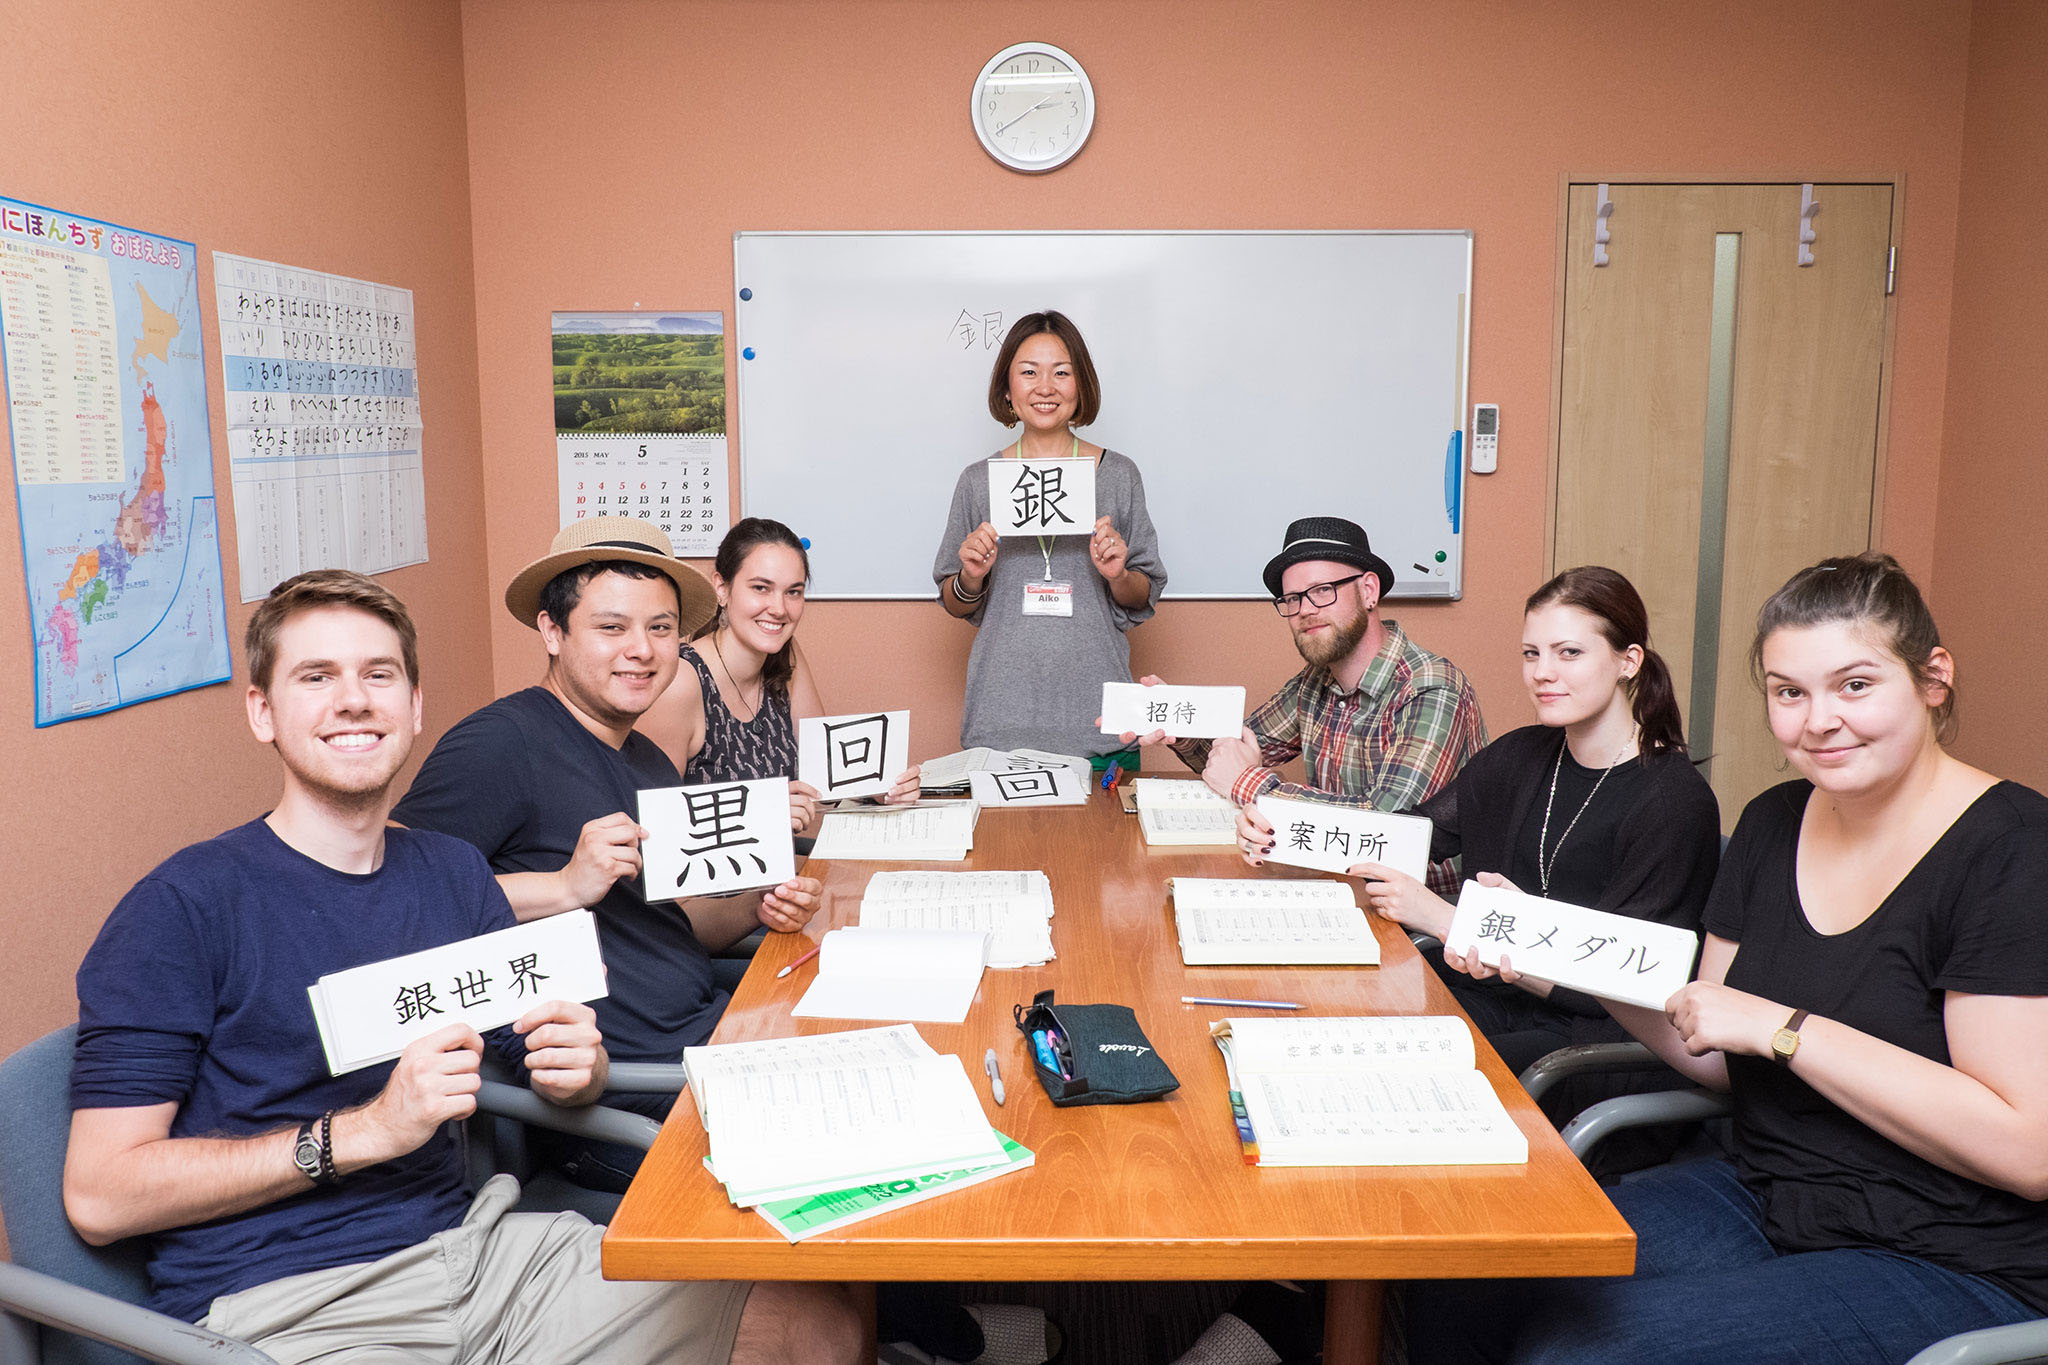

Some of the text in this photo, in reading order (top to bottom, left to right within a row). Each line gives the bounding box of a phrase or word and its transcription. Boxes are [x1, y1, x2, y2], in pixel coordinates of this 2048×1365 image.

[1010, 65, 1020, 77] 11
[1028, 60, 1040, 73] 12
[994, 82, 1071, 95] 10 2
[988, 100, 1078, 118] 9 3
[995, 121, 1071, 139] 8 4
[1011, 136, 1056, 156] 7 6 5
[1, 207, 104, 250] にほんちず
[110, 231, 182, 270] おぼえよう
[947, 308, 1005, 350] 銀
[574, 451, 589, 459] 2015
[637, 445, 648, 458] 5
[682, 468, 710, 476] 1 2
[577, 481, 710, 490] 3 4 5 6 7 8 9
[576, 496, 712, 504] 10 11 12 13 14 15 16
[1009, 463, 1076, 528] 銀
[576, 510, 586, 518] 17
[638, 510, 650, 518] 20
[660, 510, 670, 518] 21
[680, 510, 692, 518] 22
[701, 510, 713, 518] 23
[660, 524, 714, 533] 28 29 30
[1038, 594, 1059, 602] Aiko
[1146, 701, 1197, 724] 招待
[822, 713, 889, 792] 回
[991, 770, 1058, 801] 回
[676, 784, 768, 888] 黒
[1288, 820, 1389, 862] 案内所
[1476, 908, 1661, 975] 銀メダル
[392, 952, 551, 1025] 銀世界
